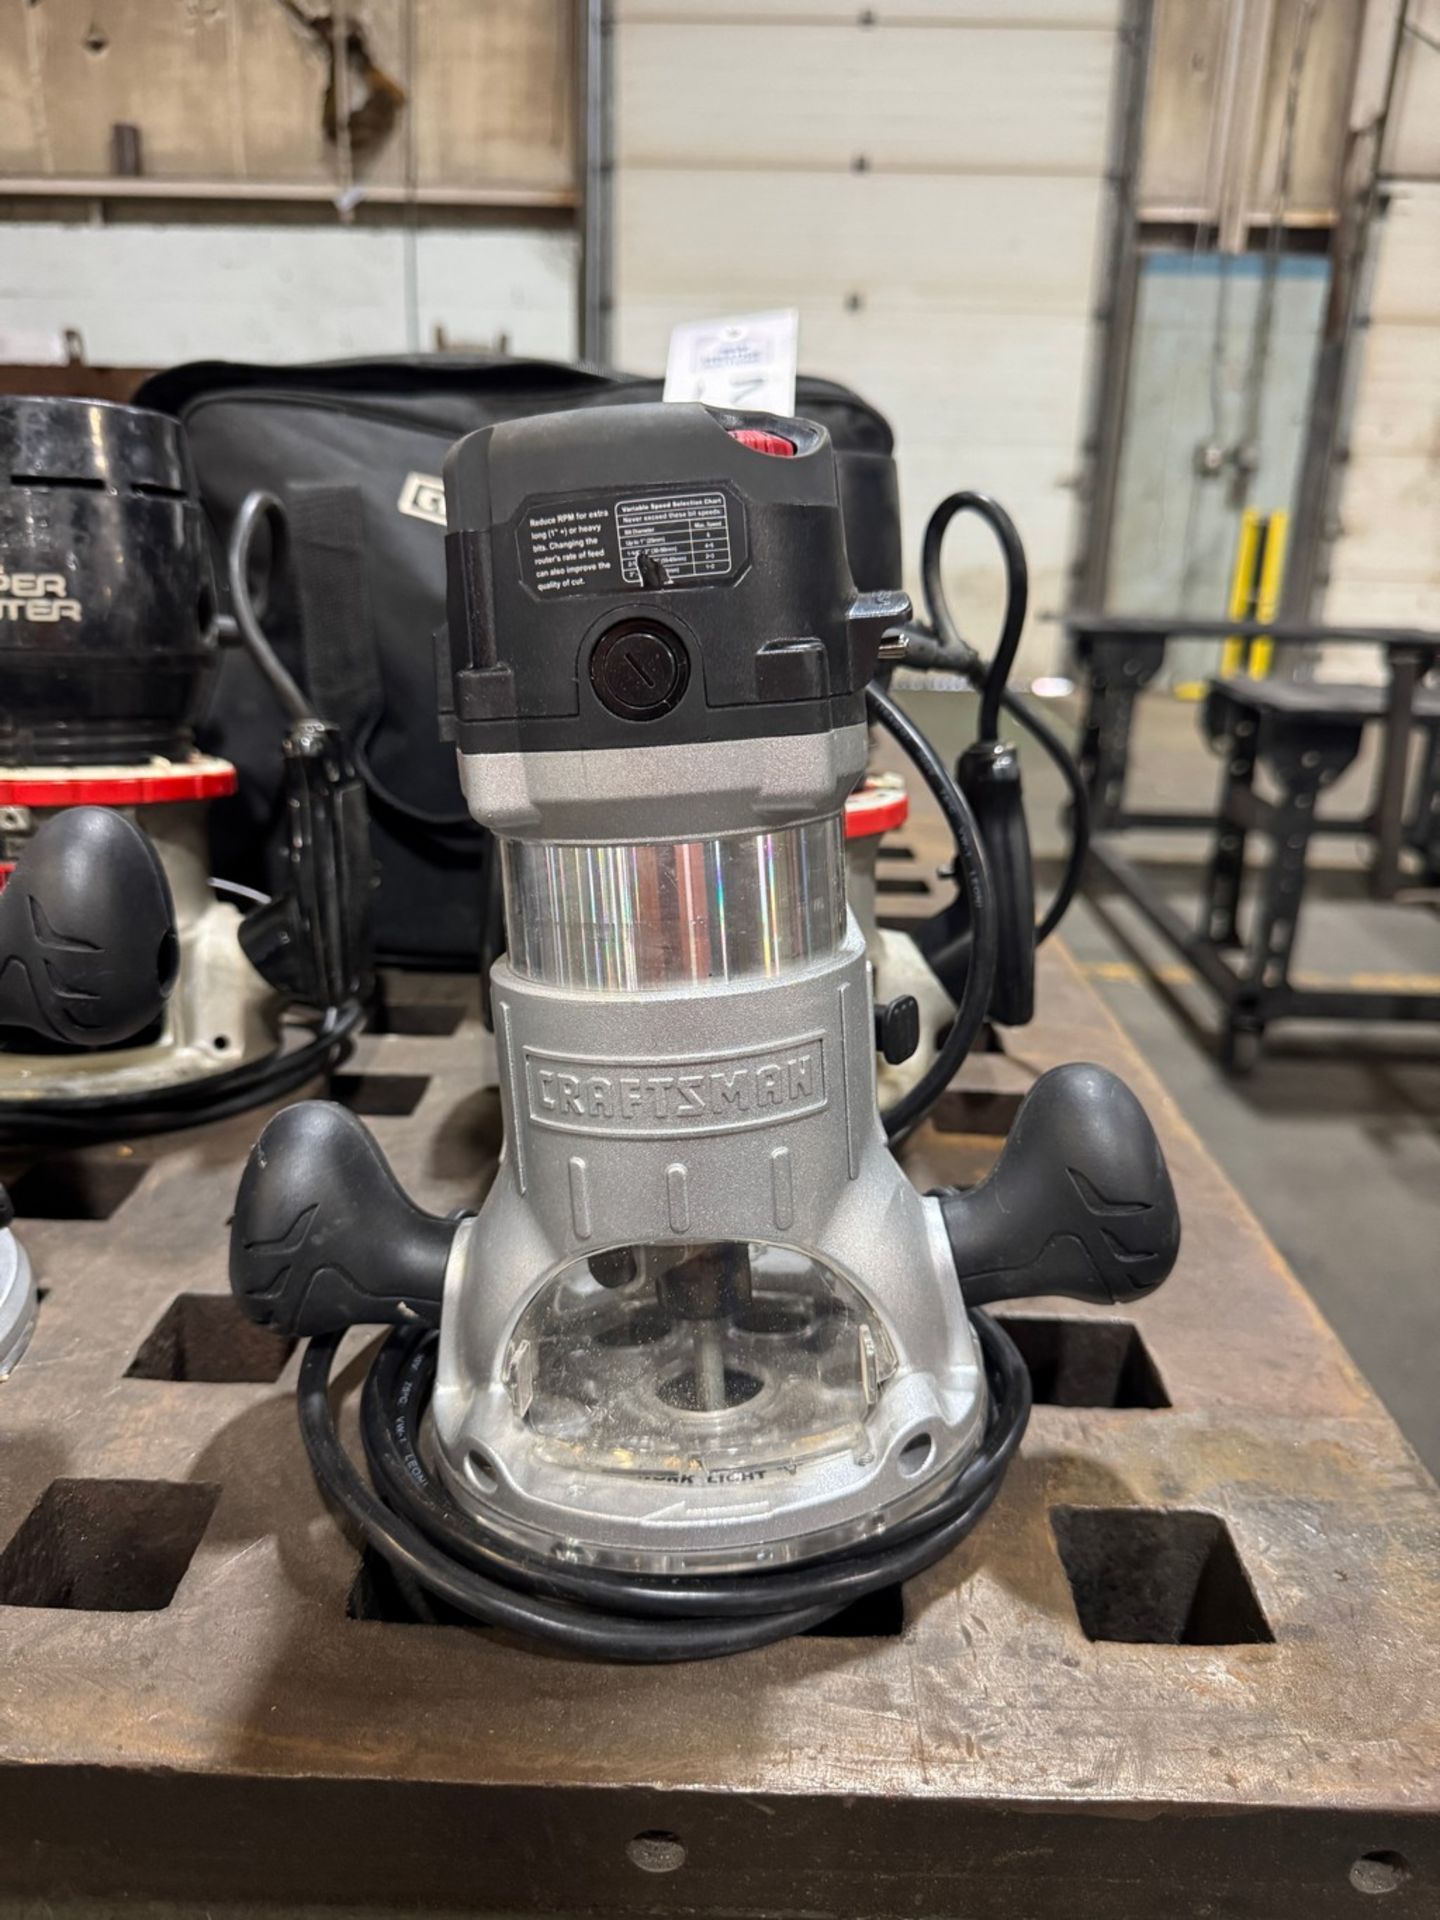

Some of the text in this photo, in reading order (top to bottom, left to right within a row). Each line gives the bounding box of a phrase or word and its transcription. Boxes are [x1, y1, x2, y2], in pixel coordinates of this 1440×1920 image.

[621, 497, 722, 513] Variable Speed Selection Chart
[529, 509, 609, 527] Reduce RPM for extra
[623, 515, 642, 523] Never
[643, 513, 667, 521] exceed
[668, 511, 687, 519] these
[530, 531, 547, 541] long
[568, 527, 577, 535] or
[578, 524, 602, 533] heavy
[532, 537, 599, 553] bits. Changing the
[534, 548, 606, 565] router's rate of feed
[536, 561, 612, 579] can also improve the
[537, 577, 586, 592] quality of cut.
[538, 1055, 814, 1118] CRAFTSMAN
[404, 1453, 429, 1487] LEONI
